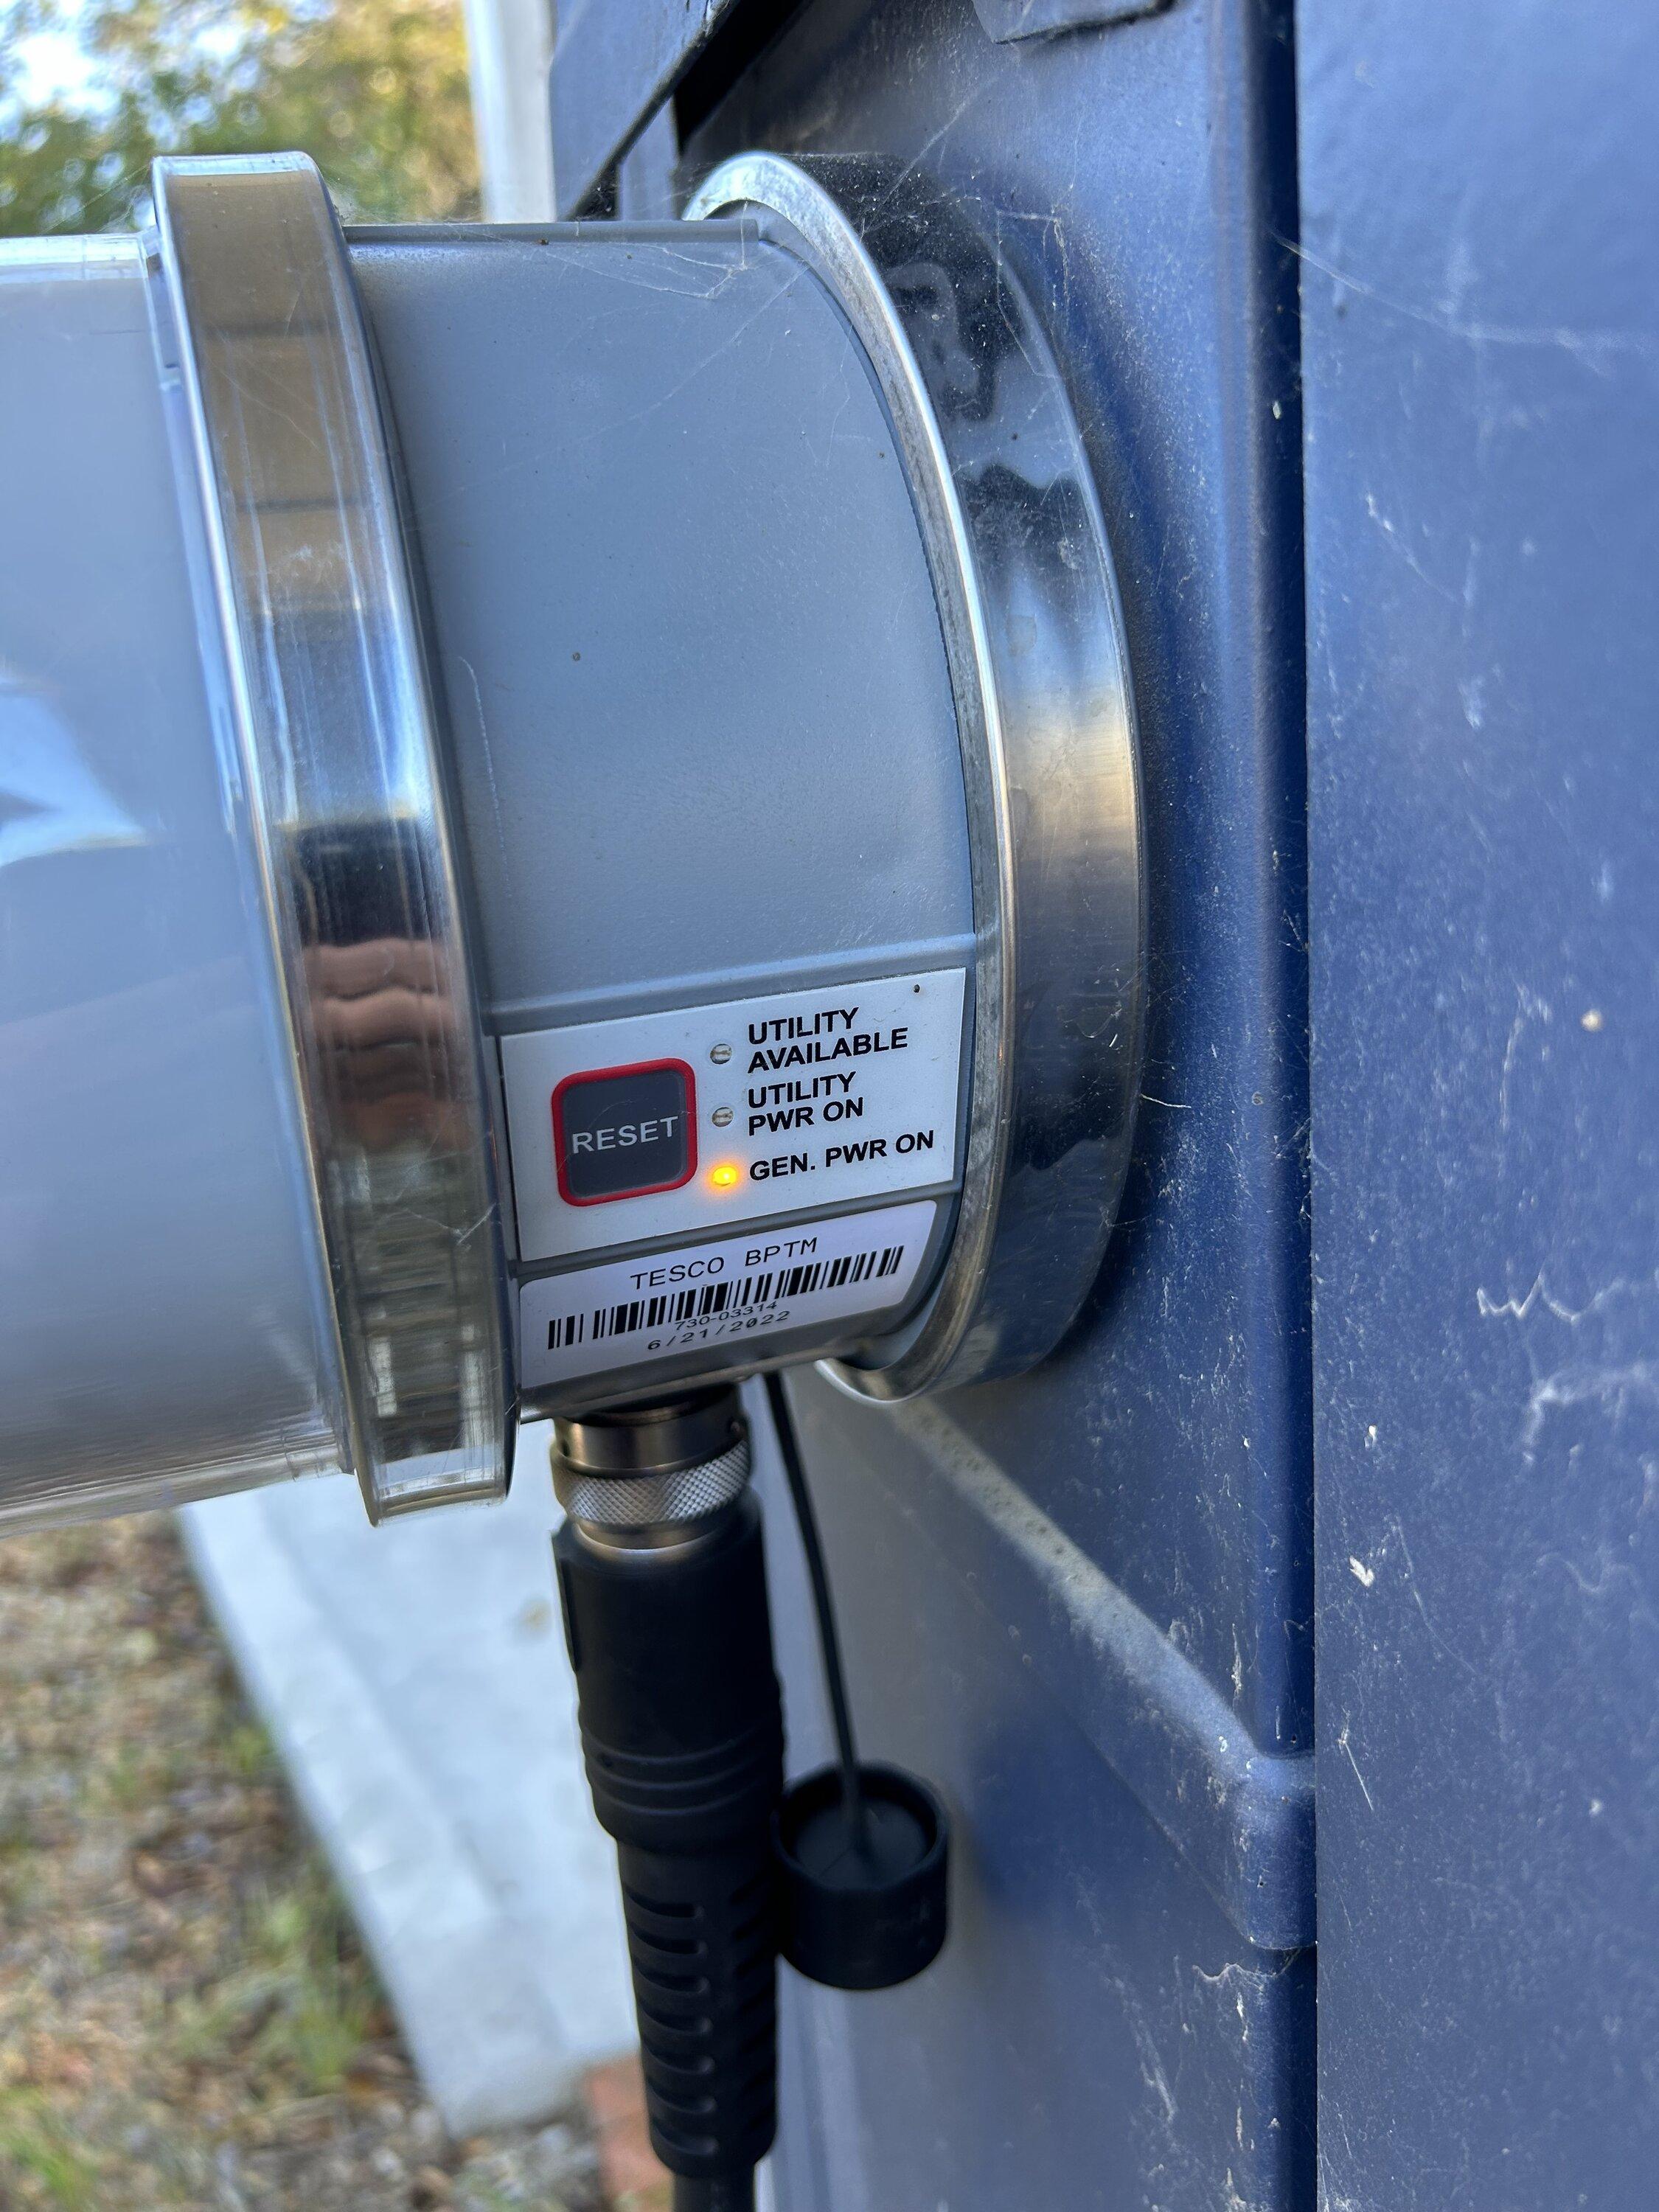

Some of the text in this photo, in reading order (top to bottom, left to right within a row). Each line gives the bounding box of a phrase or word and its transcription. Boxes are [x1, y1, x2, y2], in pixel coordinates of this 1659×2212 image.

[748, 1007, 859, 1045] UTILITY
[747, 1028, 908, 1074] AVAILABLE
[748, 1071, 856, 1108] UTILITY
[571, 1116, 679, 1153] RESET
[748, 1097, 864, 1135] PWR ON
[750, 1130, 934, 1181] GEN. PWR ON
[630, 1237, 817, 1290] TESCO BPTM
[647, 1310, 791, 1351] 6/21/2022
[675, 1301, 778, 1331] 730-03314
